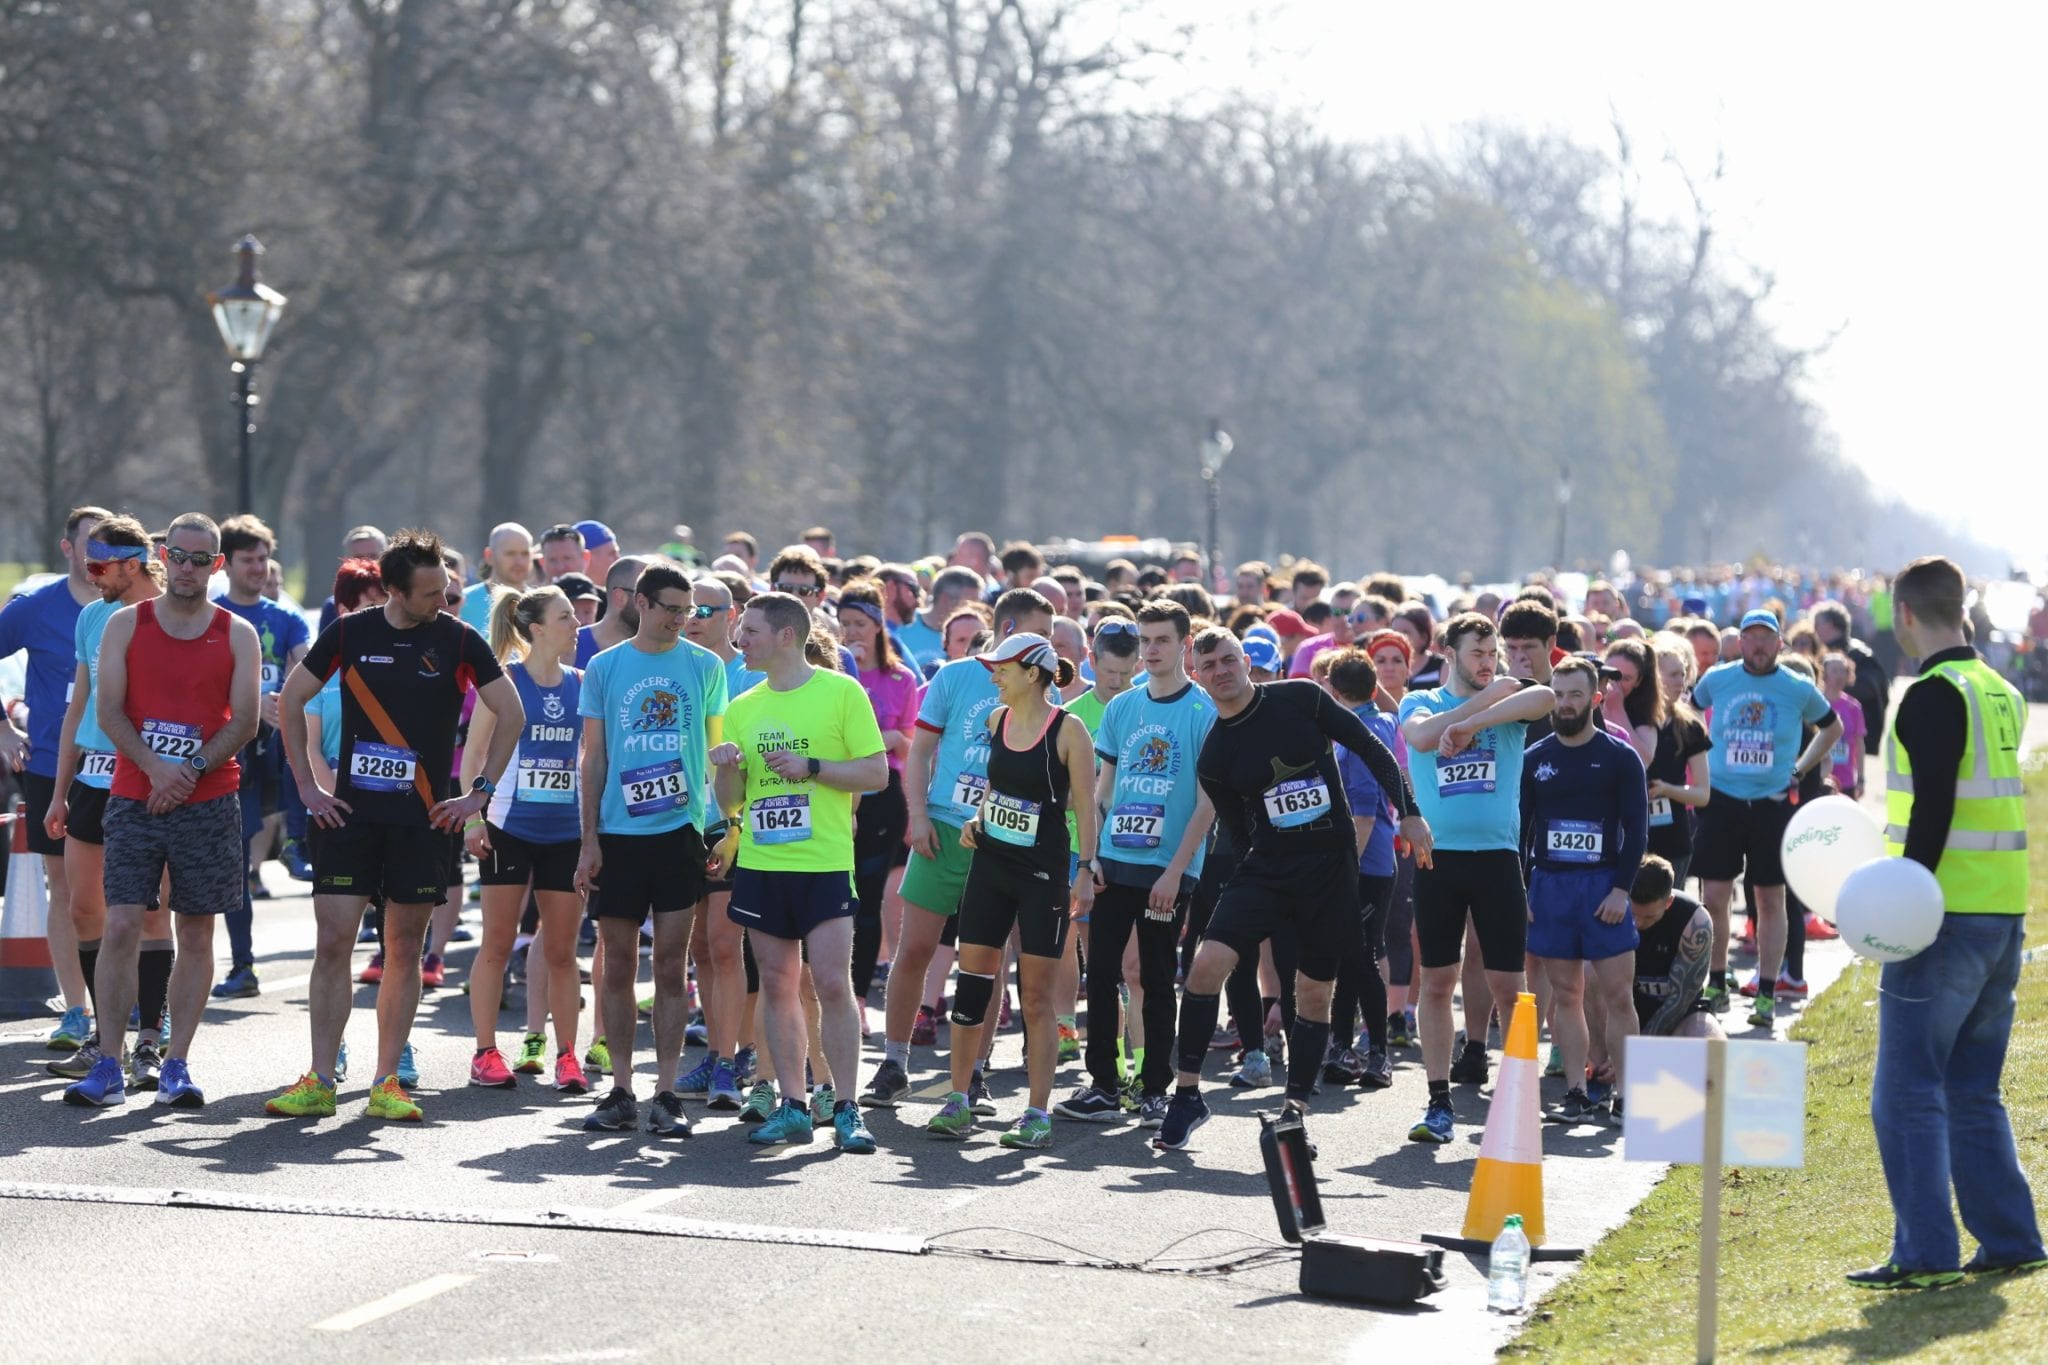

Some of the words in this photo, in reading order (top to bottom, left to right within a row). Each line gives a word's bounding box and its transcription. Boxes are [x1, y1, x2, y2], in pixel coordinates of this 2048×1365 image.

[623, 676, 670, 705] GROCERS
[670, 681, 690, 703] FUN
[681, 704, 693, 731] RUN
[968, 696, 1003, 718] GROCE
[620, 707, 631, 732] THE
[963, 719, 974, 741] THE
[171, 727, 186, 735] RUN
[531, 724, 574, 741] Fiona
[758, 732, 785, 741] TEAM
[1126, 724, 1167, 747] GROCERS
[1165, 730, 1180, 750] FUN
[146, 733, 195, 759] 1222
[641, 734, 689, 752] IGBF
[757, 738, 809, 754] DUNNES
[357, 756, 407, 778] 3289
[1121, 748, 1130, 770] THE
[1169, 751, 1182, 776] RUN
[1733, 751, 1768, 764] 1030
[527, 771, 570, 790] 1729
[1444, 763, 1489, 783] 3227
[630, 774, 681, 803] 3213
[1273, 788, 1322, 814] 1633
[756, 809, 802, 830] 1642
[989, 805, 1030, 832] 1095
[1115, 816, 1156, 834] 3427
[1552, 832, 1596, 850] 3420
[1862, 934, 1921, 956] Keelin
